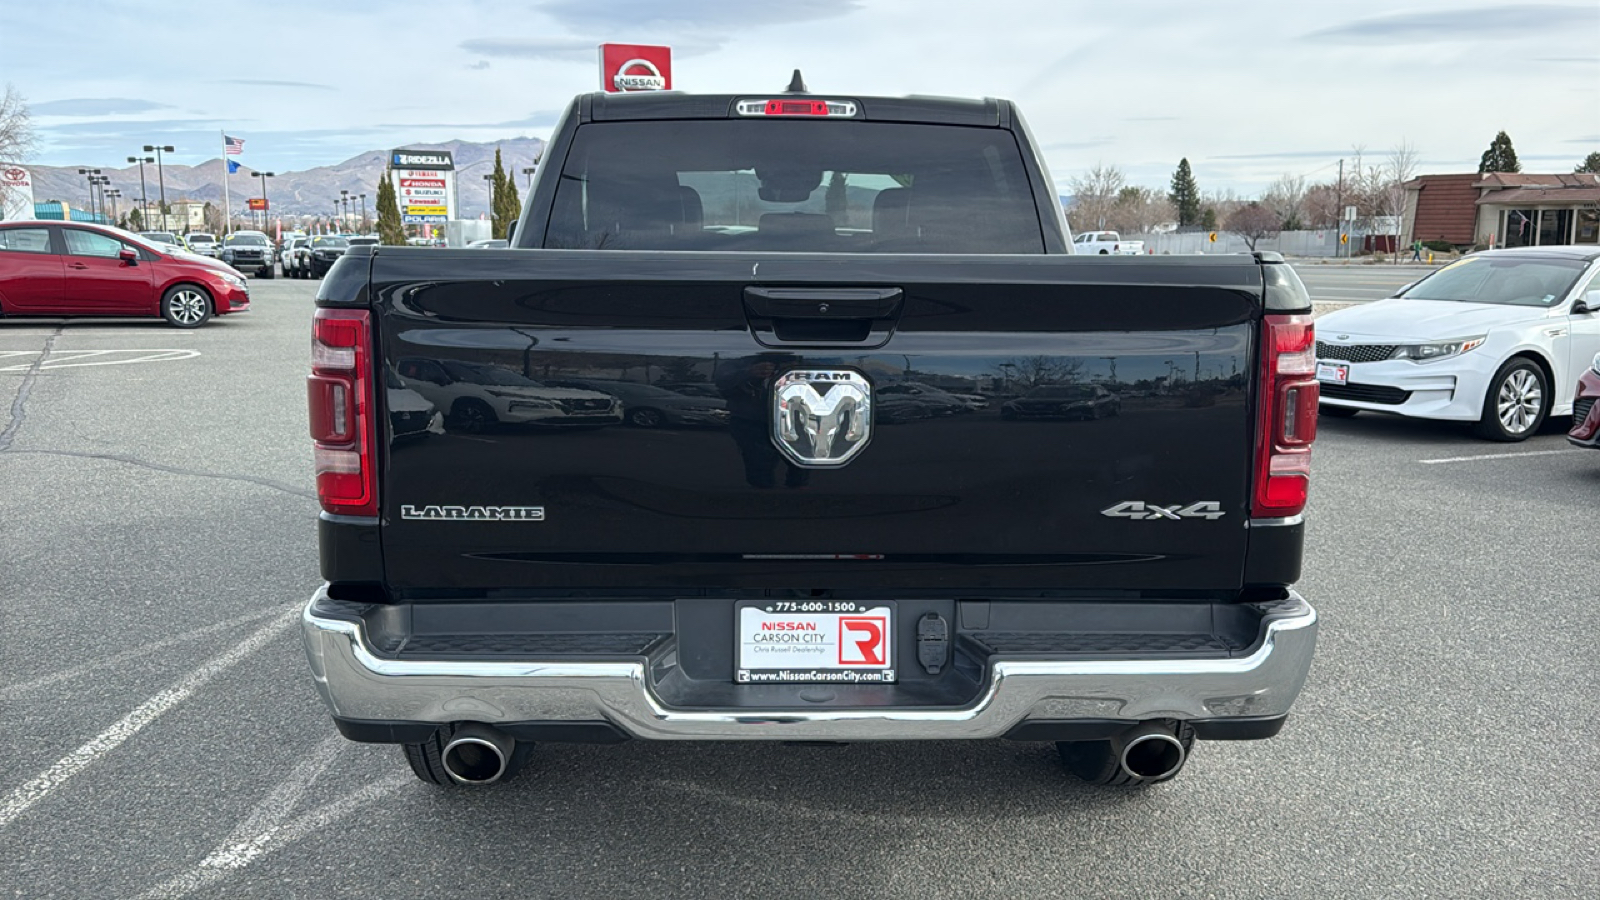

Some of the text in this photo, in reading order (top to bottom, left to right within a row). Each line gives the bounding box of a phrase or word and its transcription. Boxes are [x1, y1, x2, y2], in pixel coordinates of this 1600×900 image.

[619, 78, 661, 87] NISSAN
[408, 155, 451, 165] RIDEZILLA
[794, 372, 851, 381] RAM
[401, 504, 545, 521] LARAMIE
[1100, 500, 1226, 520] 4x4
[775, 602, 856, 612] 775-600-1500
[761, 621, 817, 631] NISSAN
[753, 633, 826, 643] CARSON CITY
[753, 645, 826, 654] Chris Russell Dealership
[751, 671, 882, 682] www.NissanCarsonCity.com
